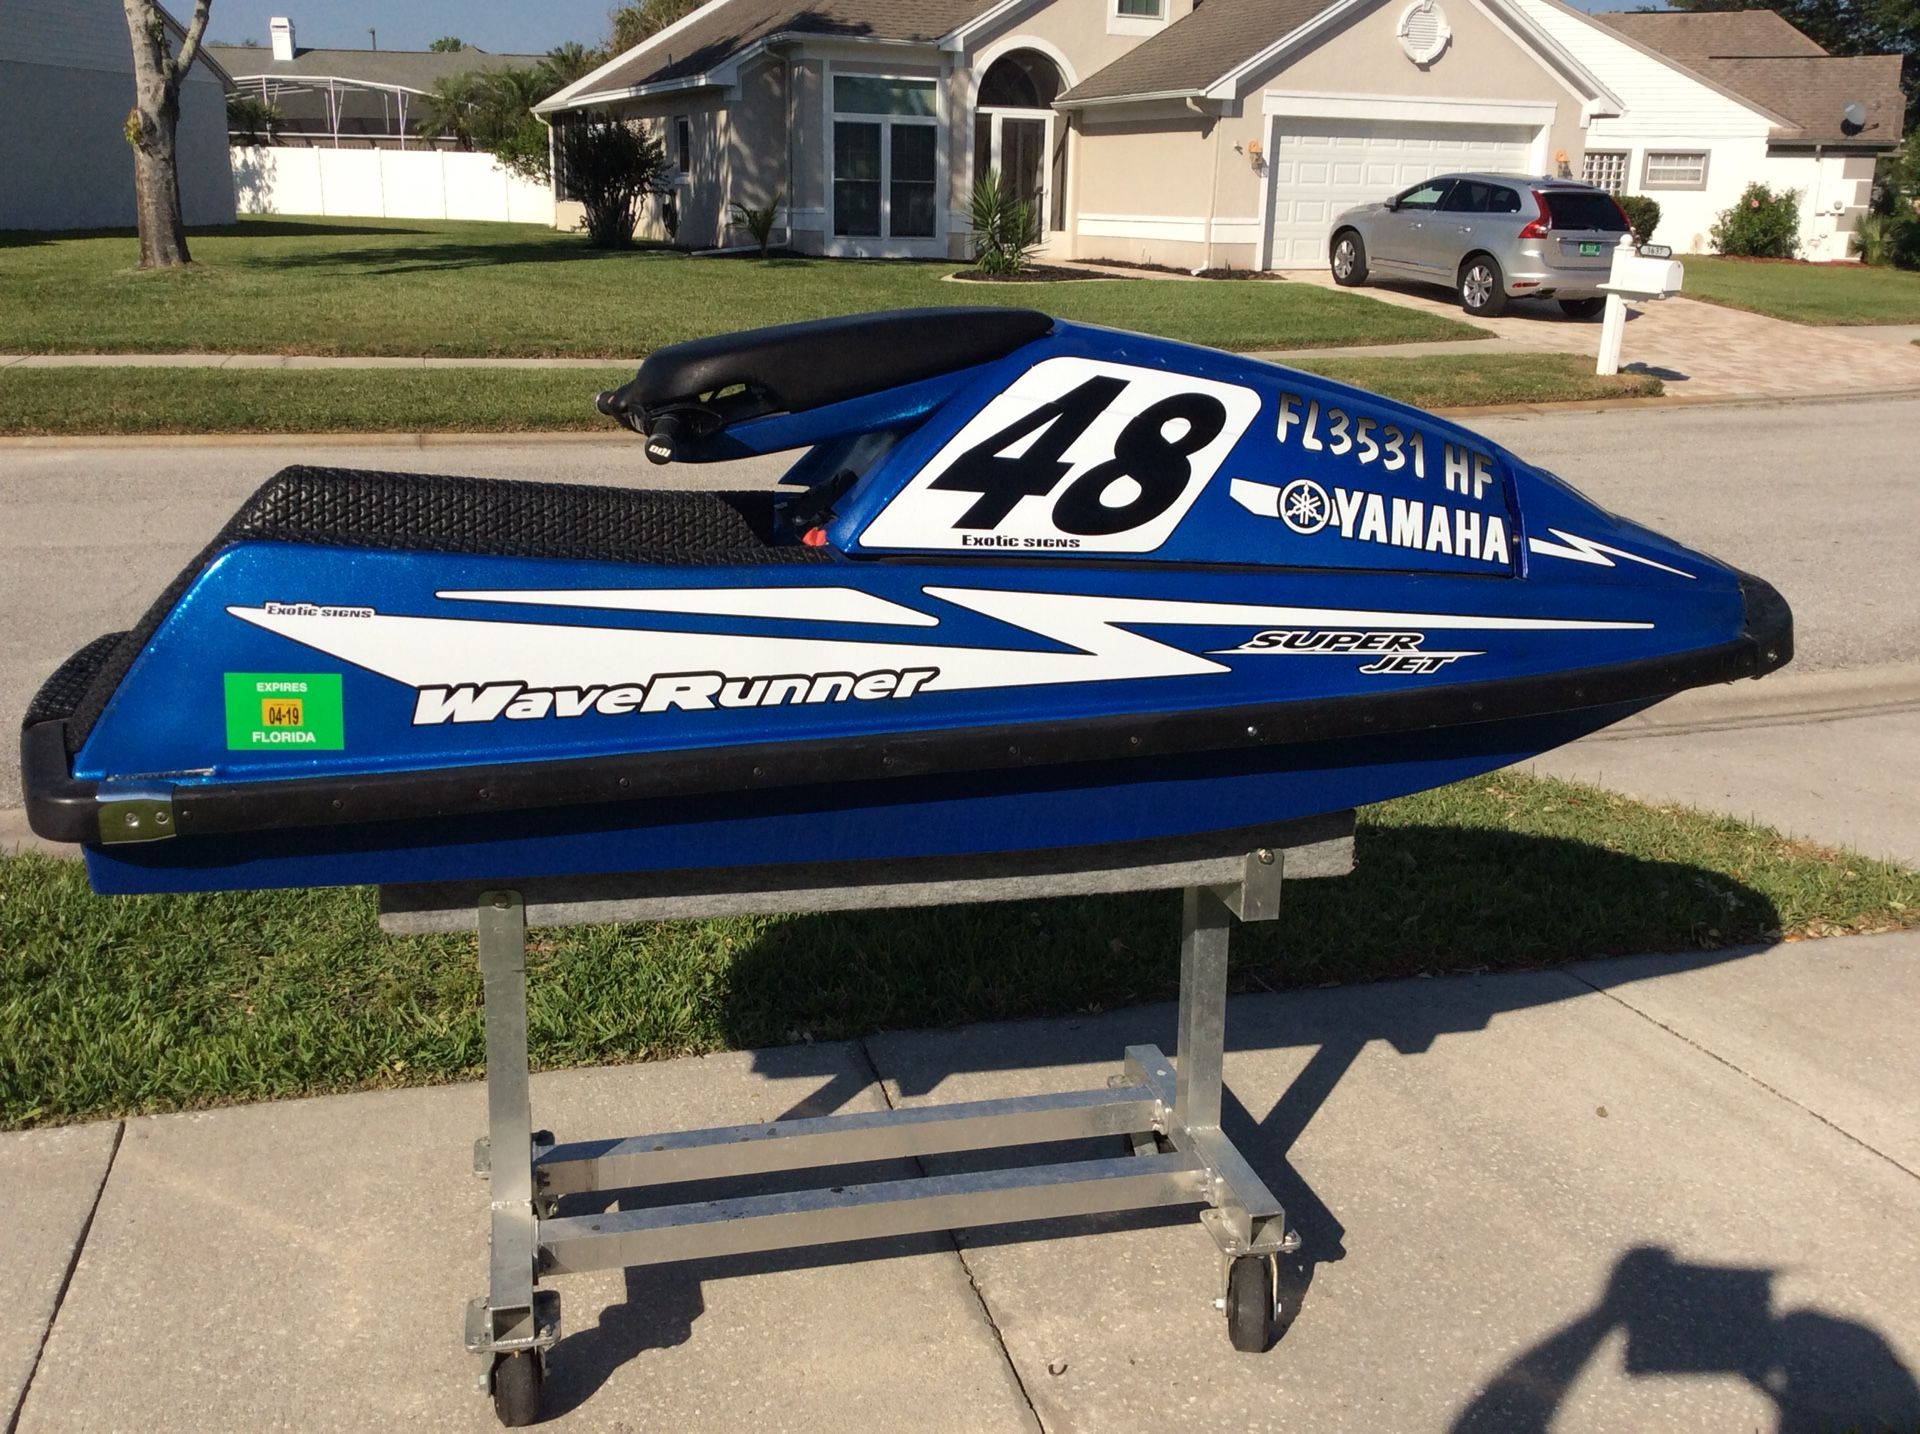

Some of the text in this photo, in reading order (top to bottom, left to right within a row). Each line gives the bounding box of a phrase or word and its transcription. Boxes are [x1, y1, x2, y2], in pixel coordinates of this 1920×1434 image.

[926, 374, 1228, 537] 48
[1276, 391, 1494, 500] FL3531 HF
[1333, 486, 1511, 565] YAMAHA
[961, 534, 1081, 548] Exotic SIGNS
[266, 604, 373, 619] Exotic SIGNS
[1244, 630, 1425, 652] SUPER
[1359, 654, 1457, 675] JET
[255, 681, 308, 693] EXPIRES
[411, 667, 941, 727] WaveRunner
[268, 706, 300, 726] 04-19
[251, 731, 317, 744] FLORIDA
